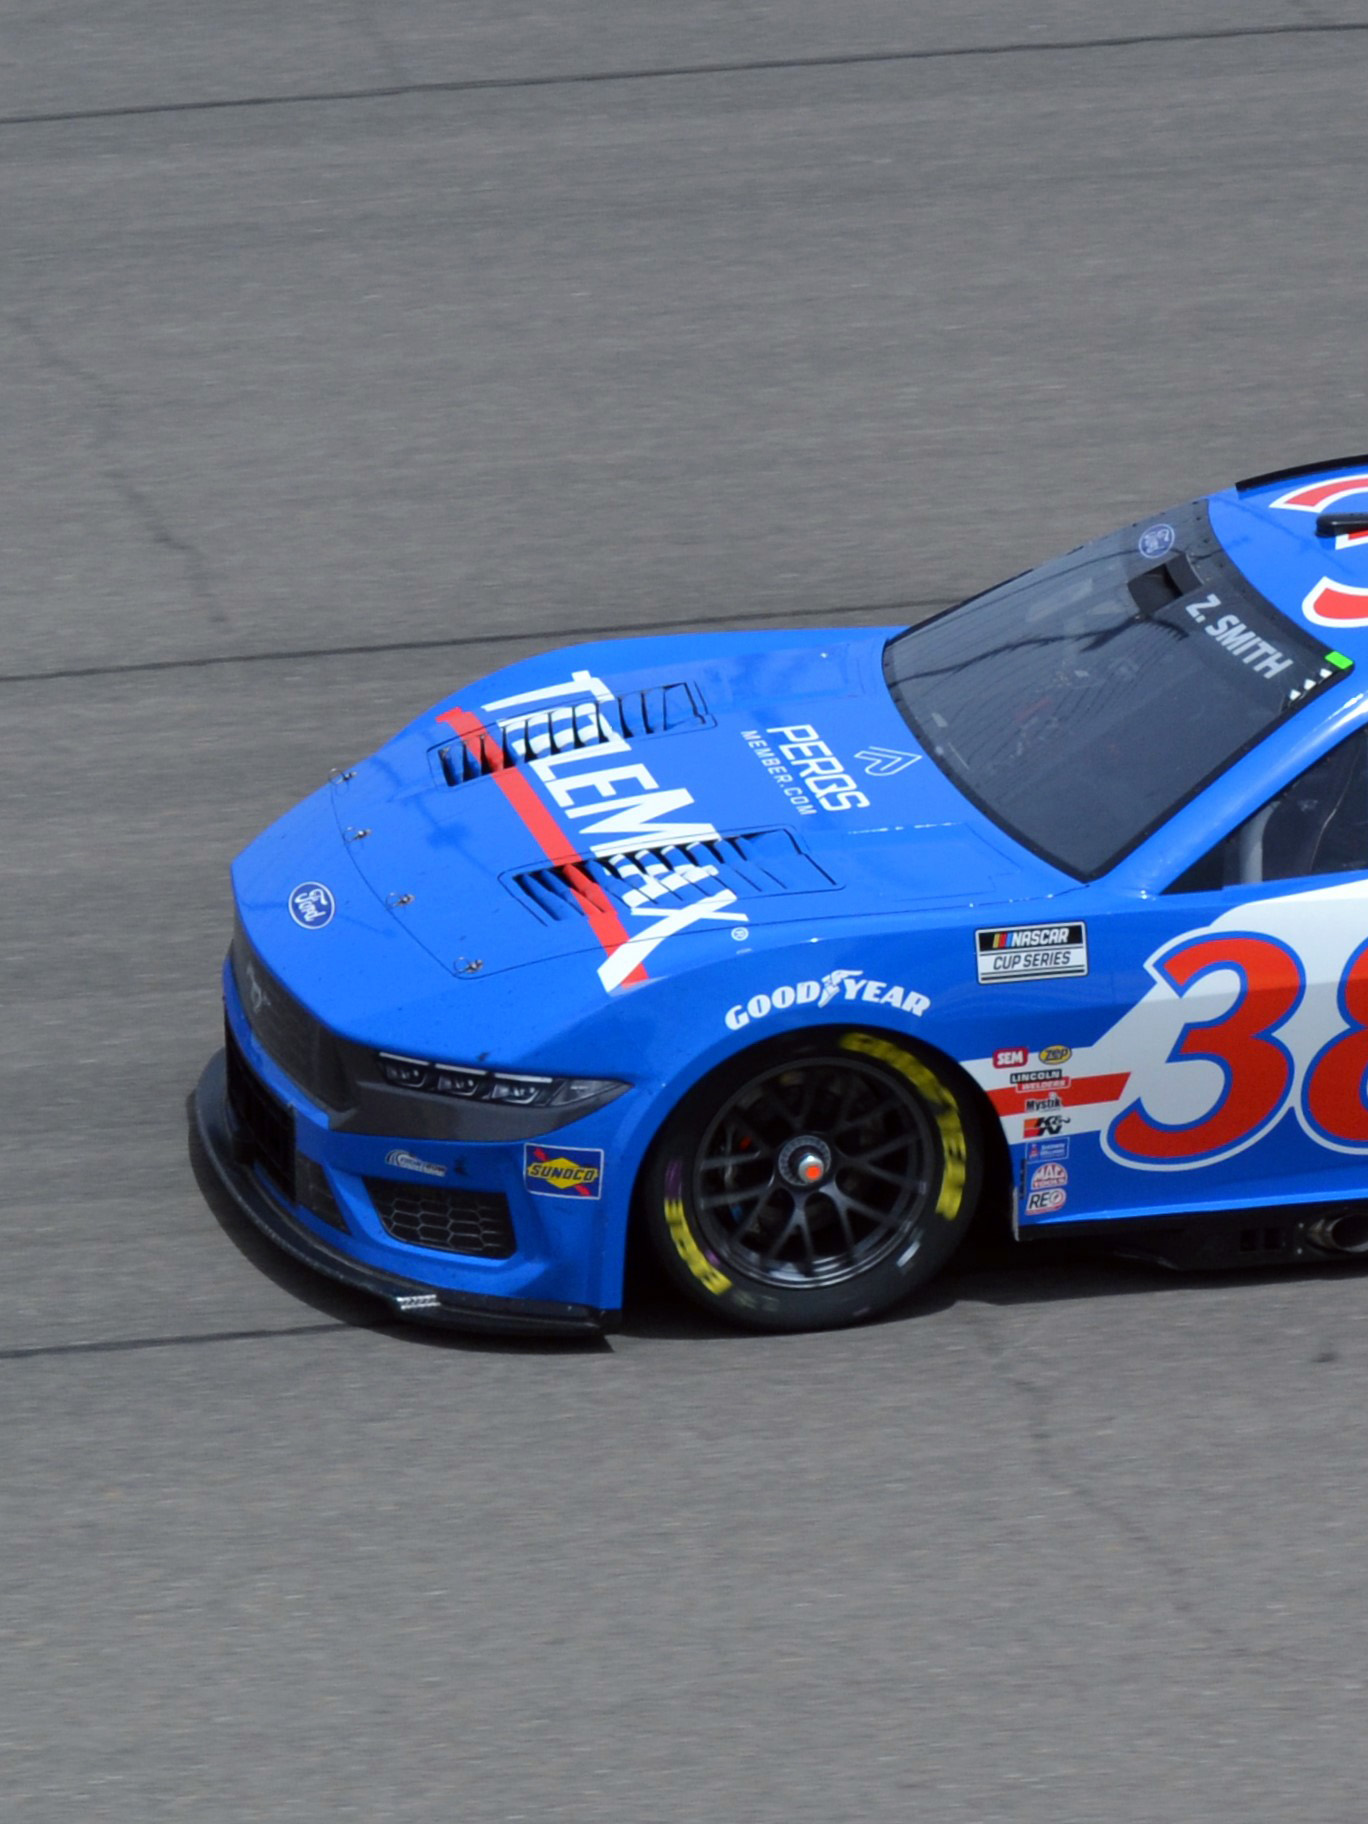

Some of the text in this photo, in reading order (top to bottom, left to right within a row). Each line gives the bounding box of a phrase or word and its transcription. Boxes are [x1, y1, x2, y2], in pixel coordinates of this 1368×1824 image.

[1185, 594, 1293, 680] Z. SMITH
[740, 729, 817, 816] MEMBER.COM
[766, 724, 870, 811] PERQS
[294, 888, 328, 922] Ford
[1011, 928, 1070, 947] NASCAR
[993, 951, 1072, 971] CUP SERIES
[997, 1050, 1024, 1066] SEM
[1011, 1070, 1060, 1082] LINCOLN
[1021, 1079, 1066, 1091] WELDERS
[528, 1163, 597, 1182] SUNOCO
